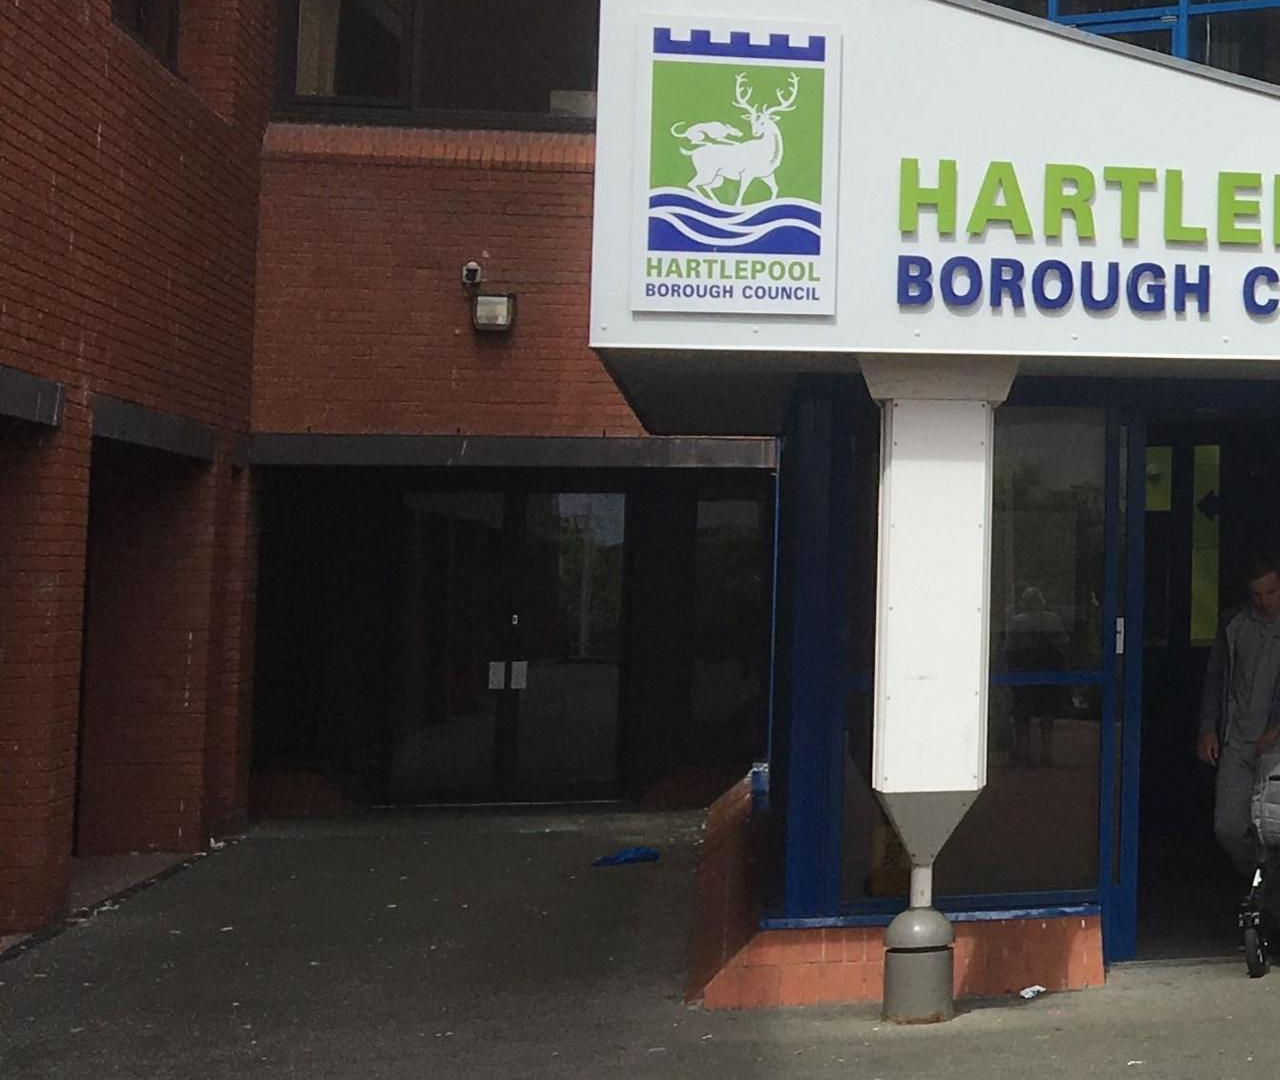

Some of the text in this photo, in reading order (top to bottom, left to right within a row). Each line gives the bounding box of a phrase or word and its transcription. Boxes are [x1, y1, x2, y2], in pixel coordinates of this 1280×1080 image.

[645, 257, 821, 281] HARTLEPOOL
[645, 283, 820, 301] BOROUGH COUNCIL
[897, 255, 1210, 313] BOROUGH
